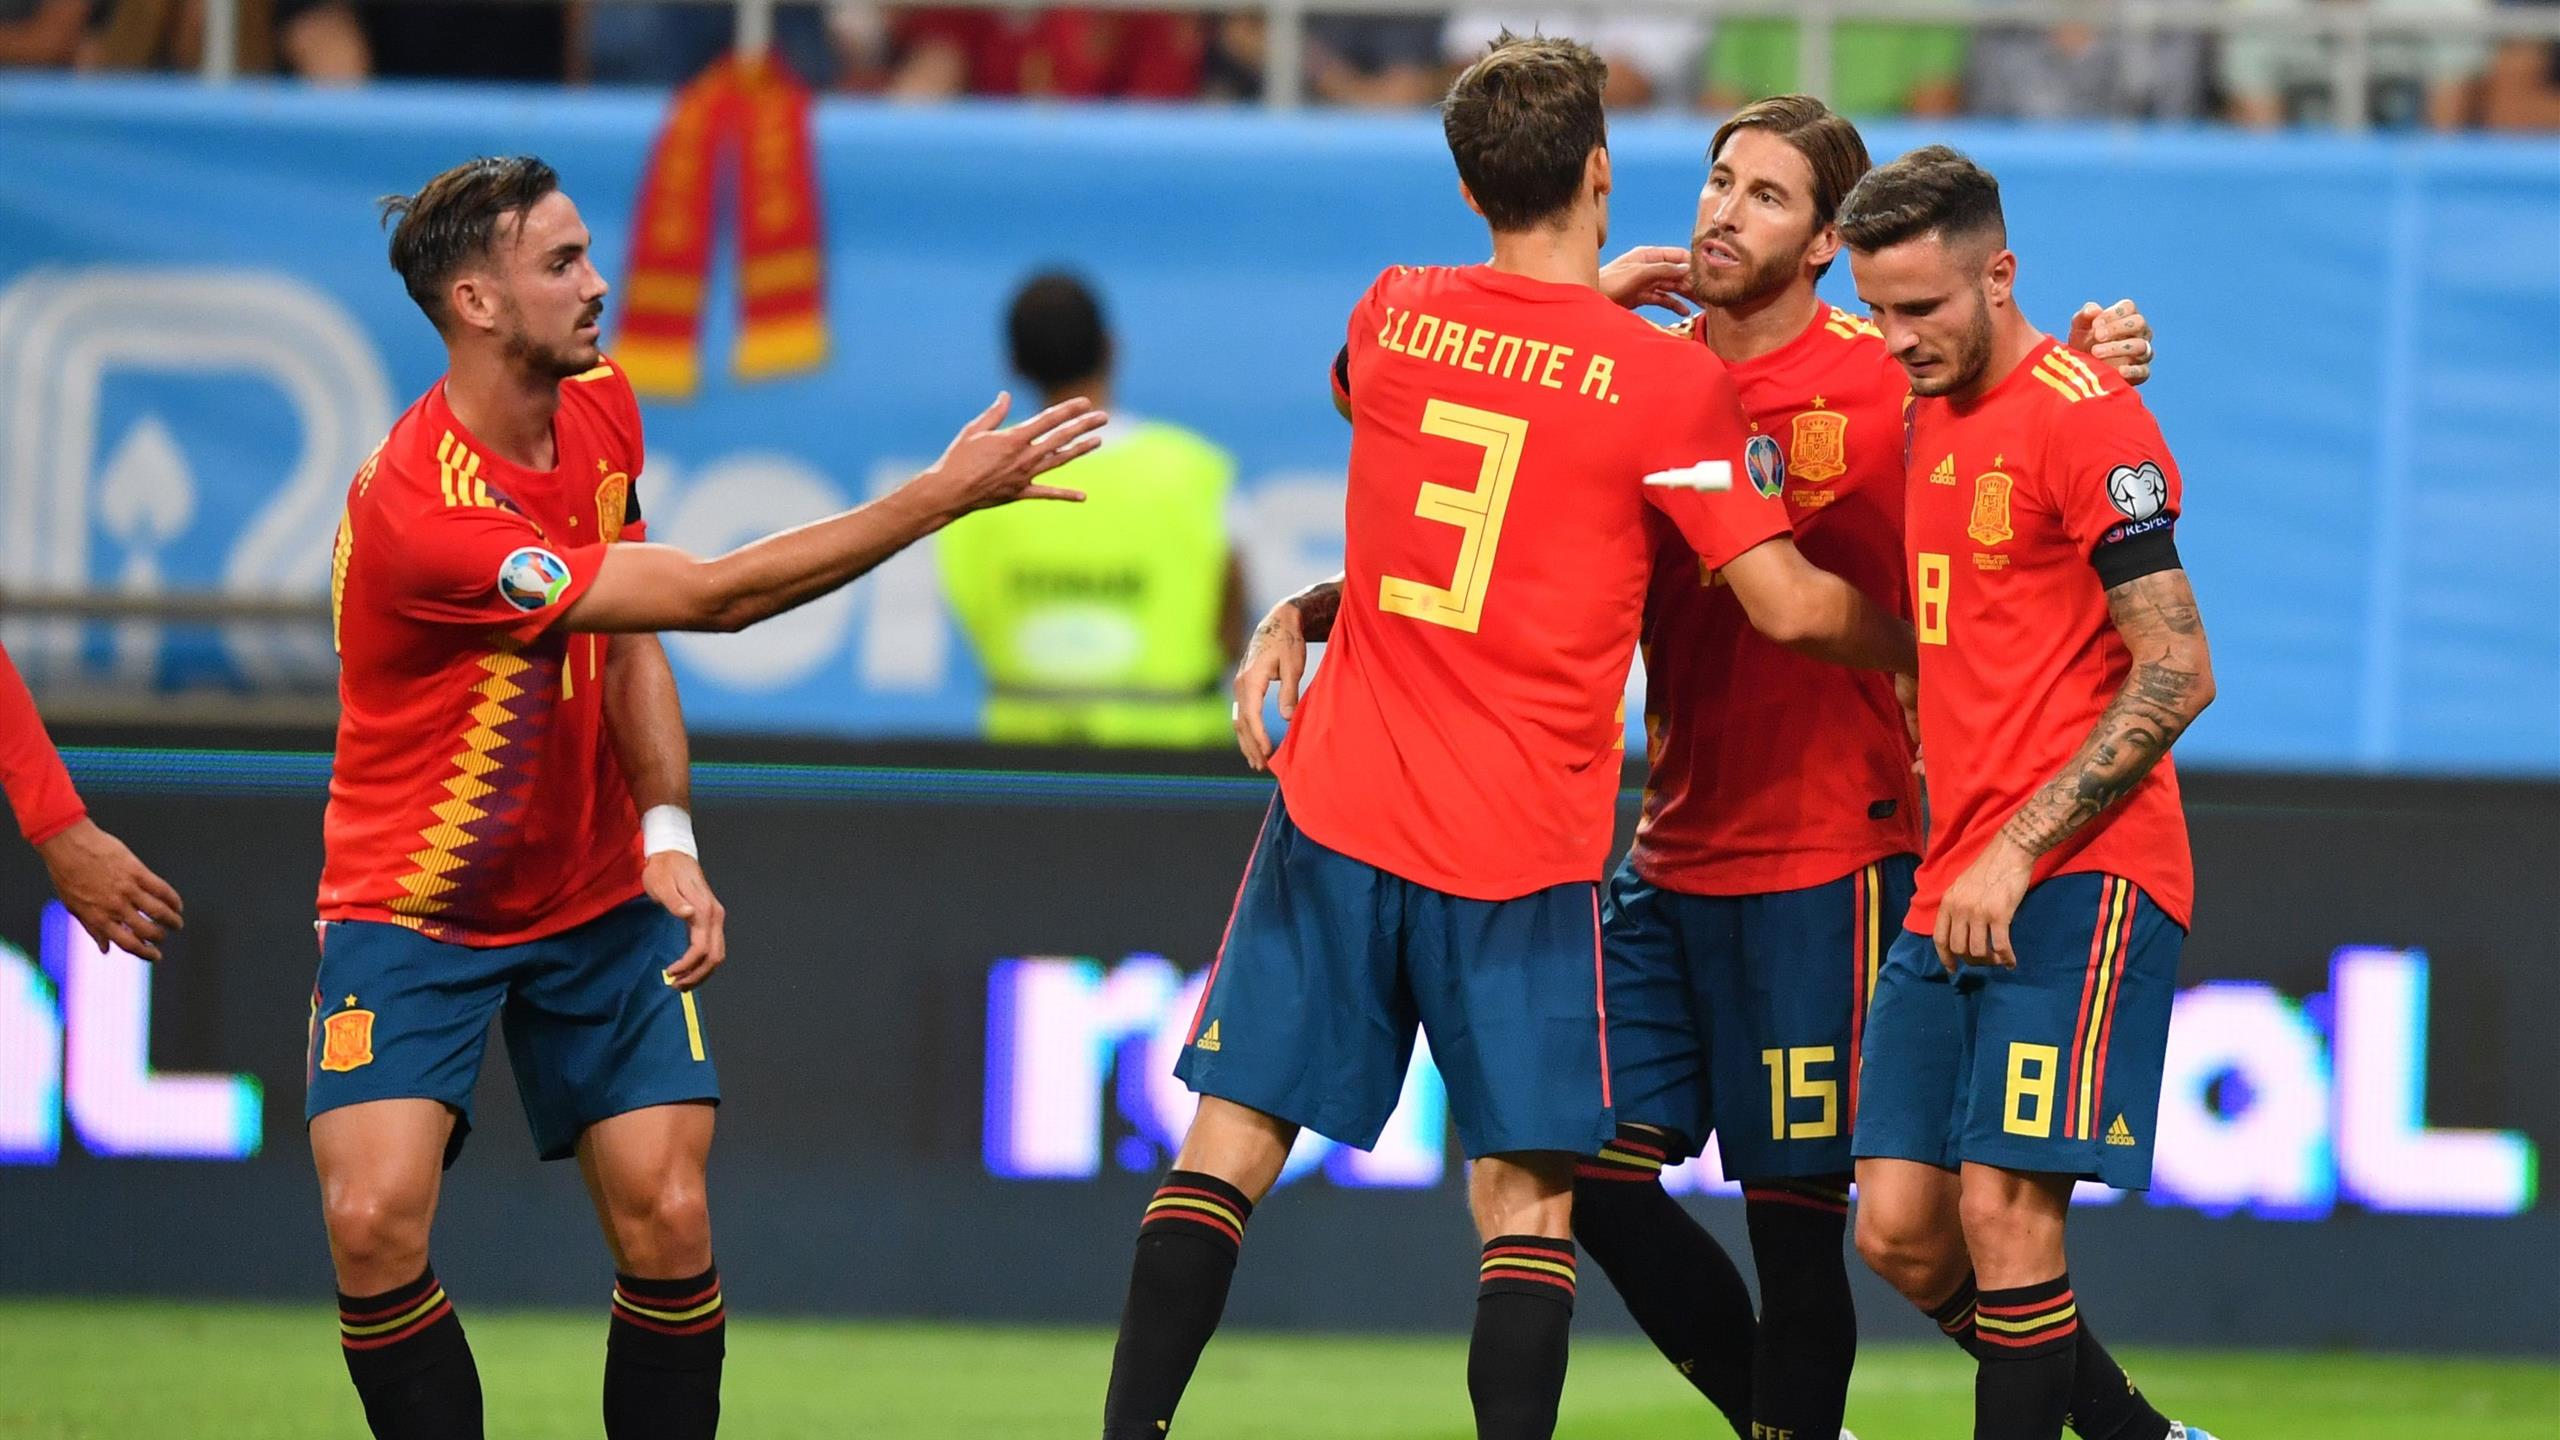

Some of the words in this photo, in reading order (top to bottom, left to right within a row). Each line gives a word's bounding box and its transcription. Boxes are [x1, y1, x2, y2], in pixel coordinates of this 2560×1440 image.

[1378, 306, 1575, 390] LLORENTE
[1378, 398, 1530, 634] 3
[1917, 551, 1950, 646] 8
[1761, 1045, 1838, 1141] 15
[2002, 1041, 2059, 1138] 8
